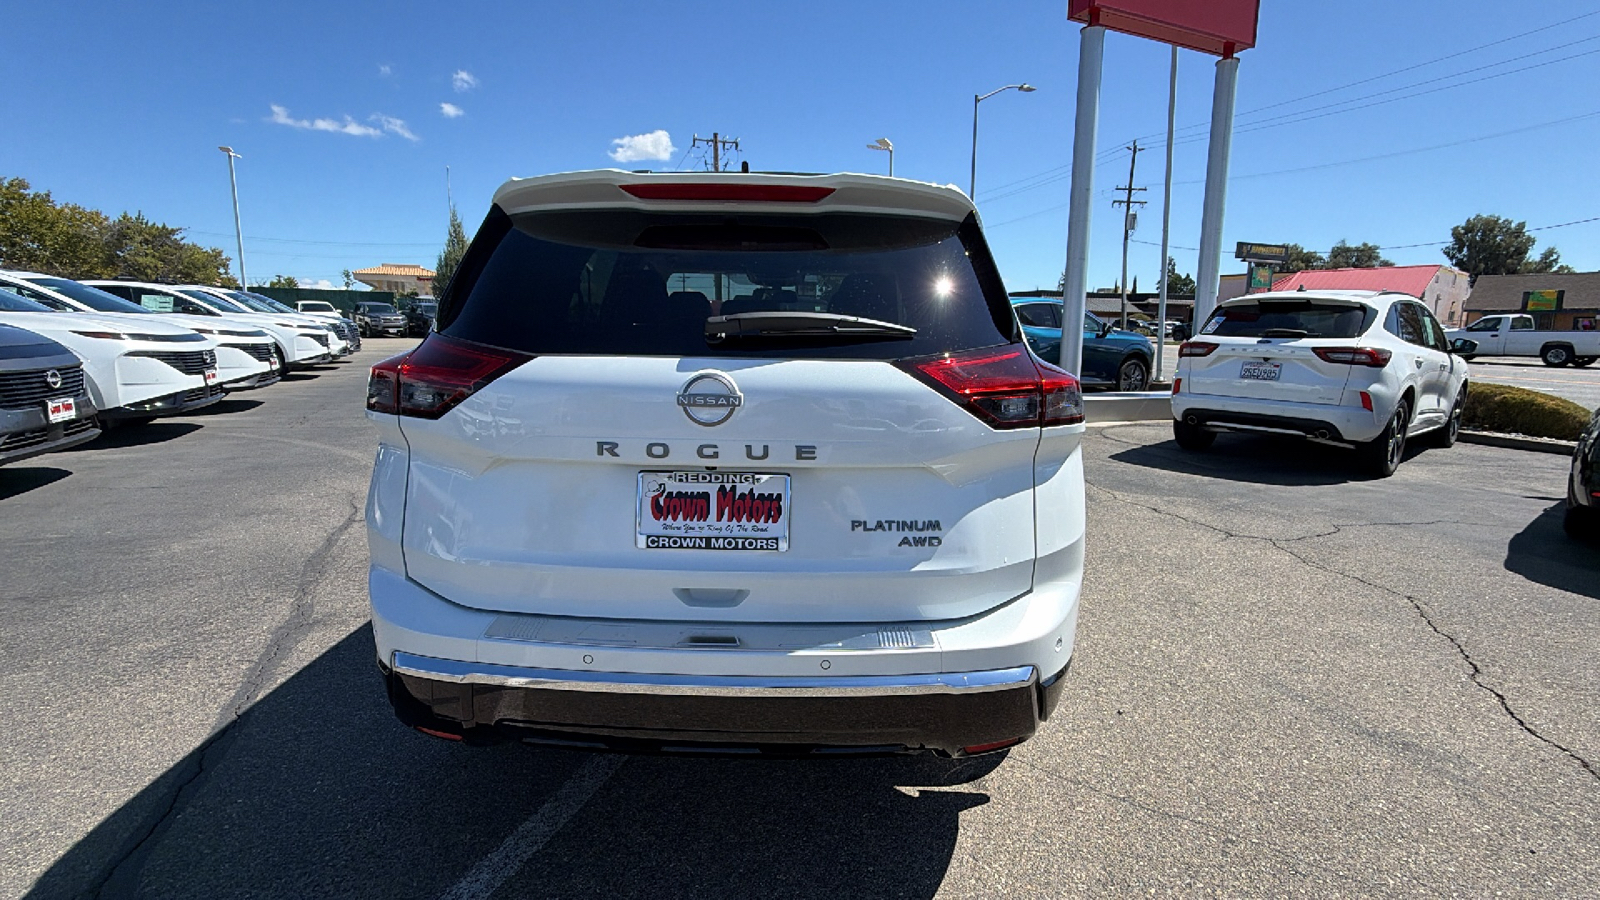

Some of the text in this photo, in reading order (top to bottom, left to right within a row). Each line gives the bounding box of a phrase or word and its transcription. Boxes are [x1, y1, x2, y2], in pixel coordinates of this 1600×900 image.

[678, 396, 739, 405] NISSAN
[596, 441, 817, 461] ROGUE
[676, 473, 754, 484] REDDING
[651, 484, 782, 523] Crown Motors
[661, 523, 681, 531] Where
[707, 525, 722, 534] King
[751, 525, 769, 533] Road
[851, 519, 942, 532] PLATINUM
[647, 536, 778, 549] CROWN MOTORS
[898, 536, 942, 547] AWD
